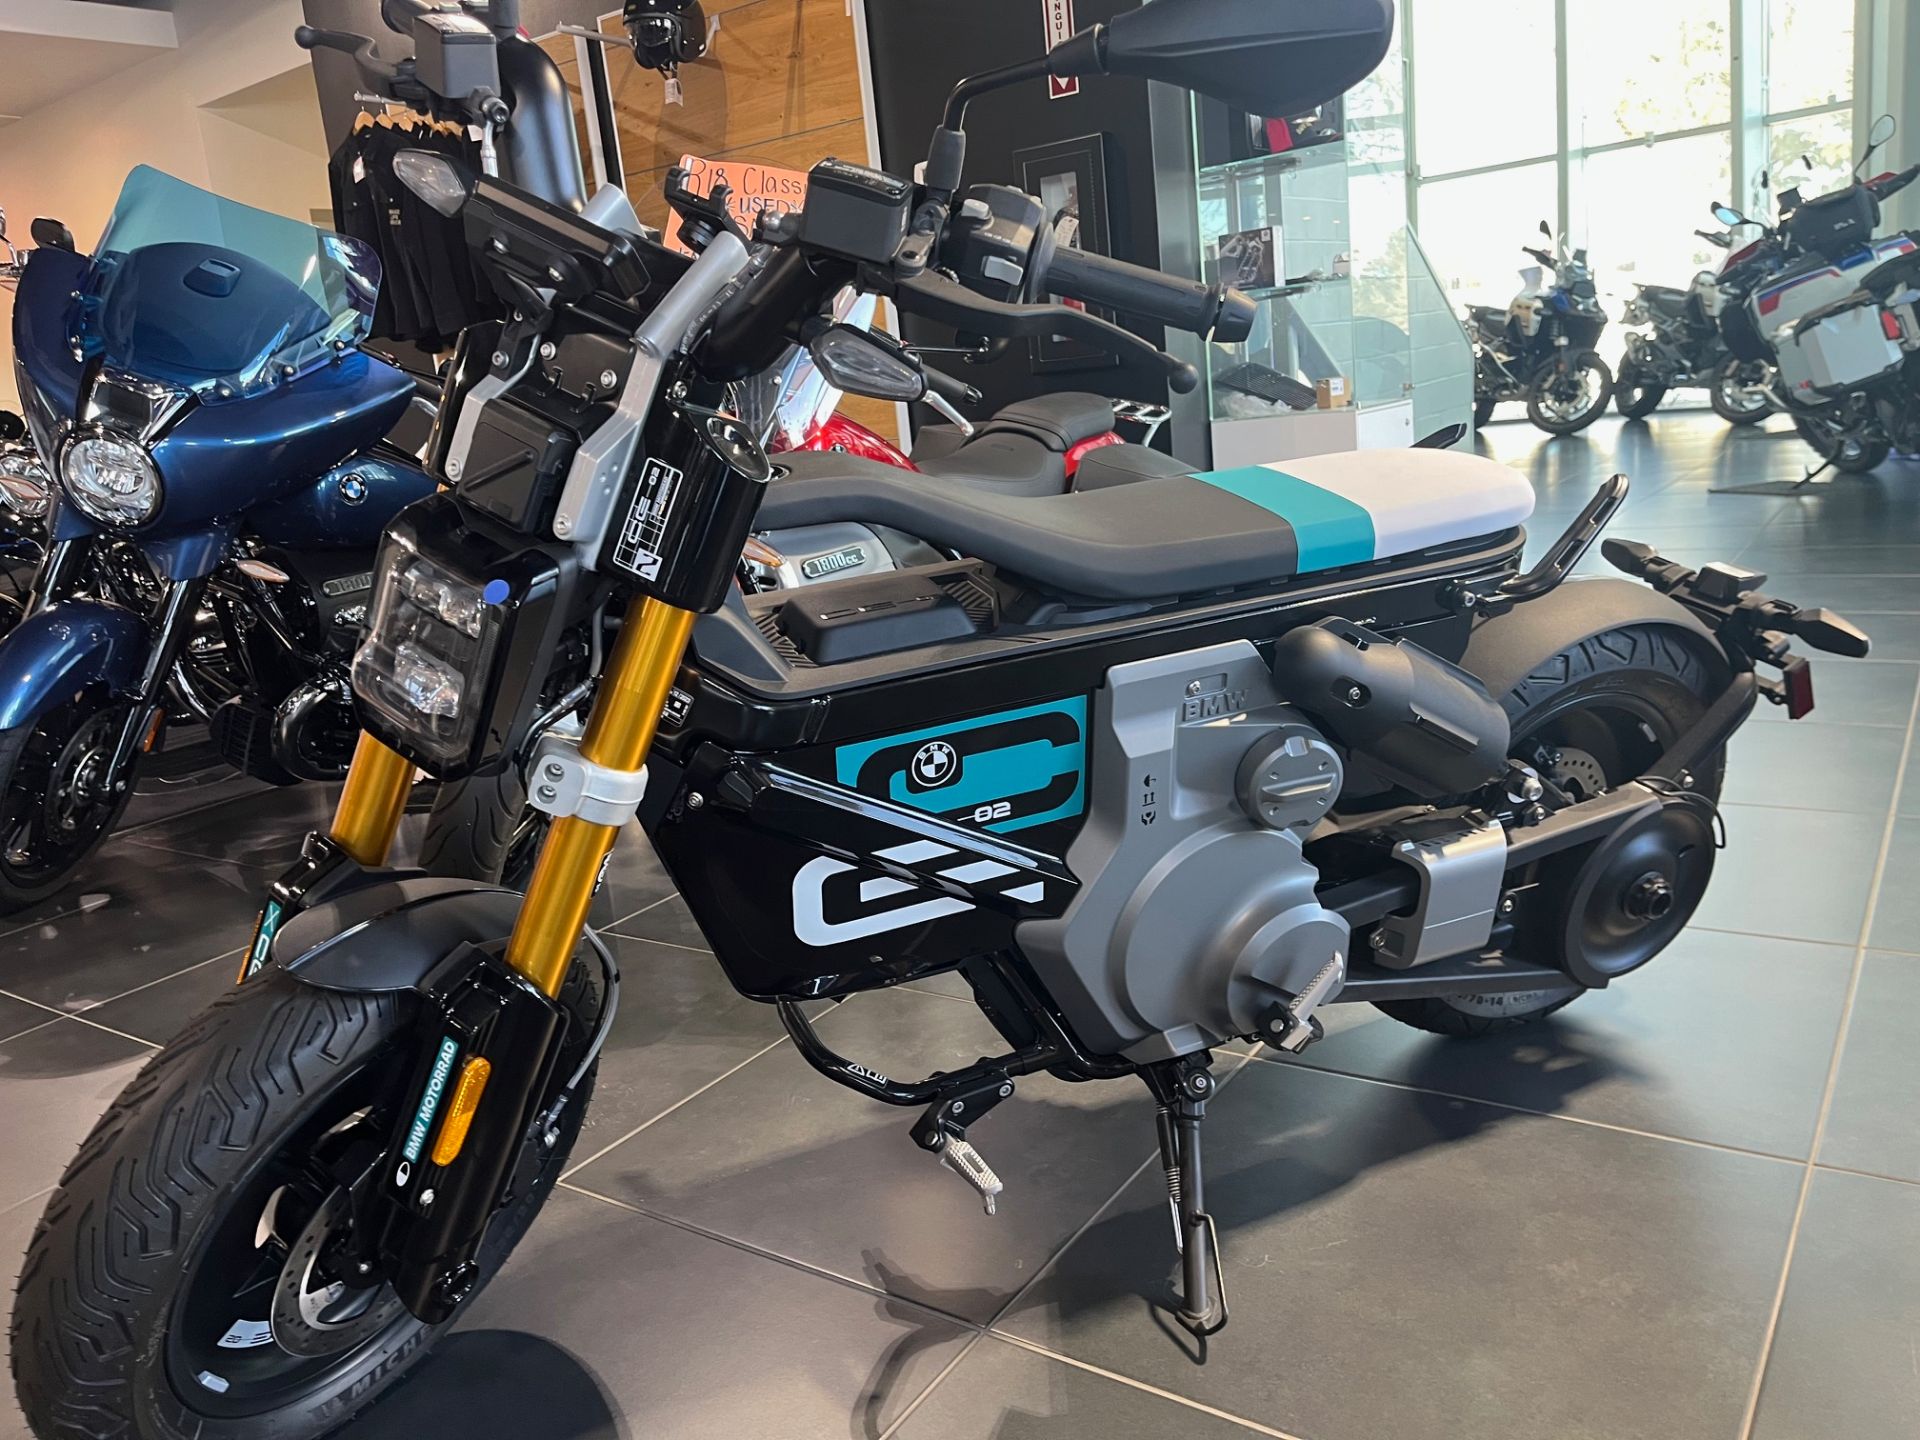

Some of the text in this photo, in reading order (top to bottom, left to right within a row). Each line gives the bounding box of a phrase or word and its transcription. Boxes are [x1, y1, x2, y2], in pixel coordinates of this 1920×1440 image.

[743, 167, 808, 195] Classi
[739, 197, 791, 214] USED
[813, 553, 858, 572] 1800cc
[1182, 688, 1251, 722] BMW
[405, 1040, 455, 1160] BMW MOTORRAD
